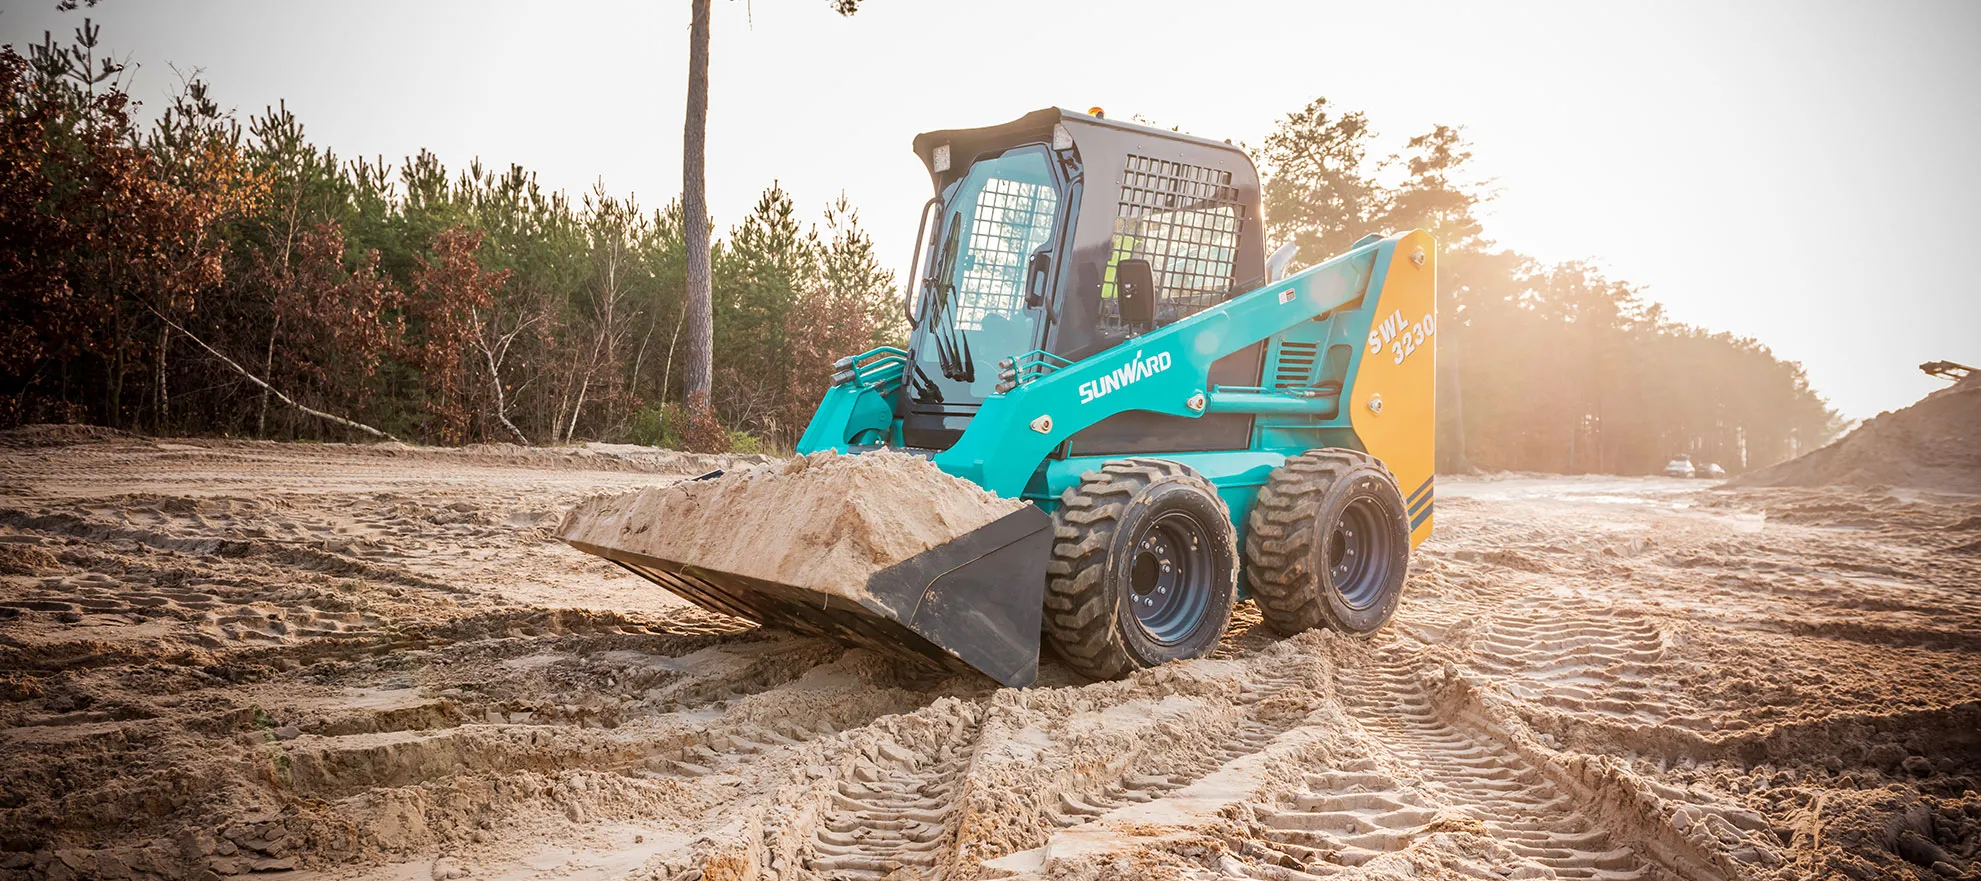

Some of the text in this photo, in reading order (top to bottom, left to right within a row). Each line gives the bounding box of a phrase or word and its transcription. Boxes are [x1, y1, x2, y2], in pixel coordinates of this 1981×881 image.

[1368, 308, 1409, 355] SWL
[1391, 313, 1435, 366] 3230
[1078, 349, 1172, 405] SUNWARD
